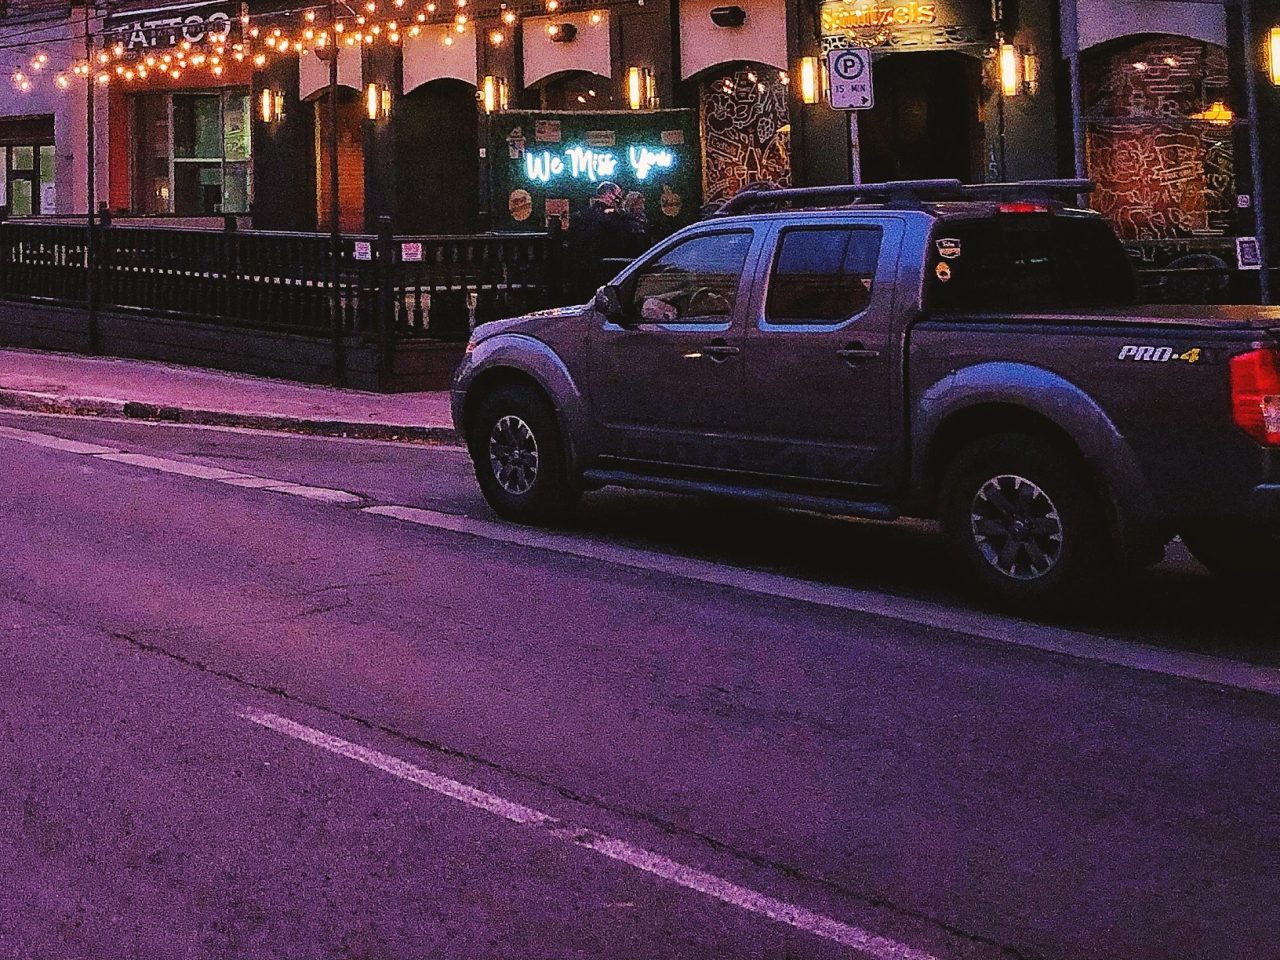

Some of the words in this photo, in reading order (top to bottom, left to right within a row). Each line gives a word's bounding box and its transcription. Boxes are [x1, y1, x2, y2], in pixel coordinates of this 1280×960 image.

[111, 12, 232, 50] TATTOO
[842, 58, 856, 73] P
[835, 83, 845, 93] 15
[851, 83, 866, 93] MIN
[525, 151, 564, 182] We
[565, 146, 618, 182] Miss
[629, 145, 673, 179] You
